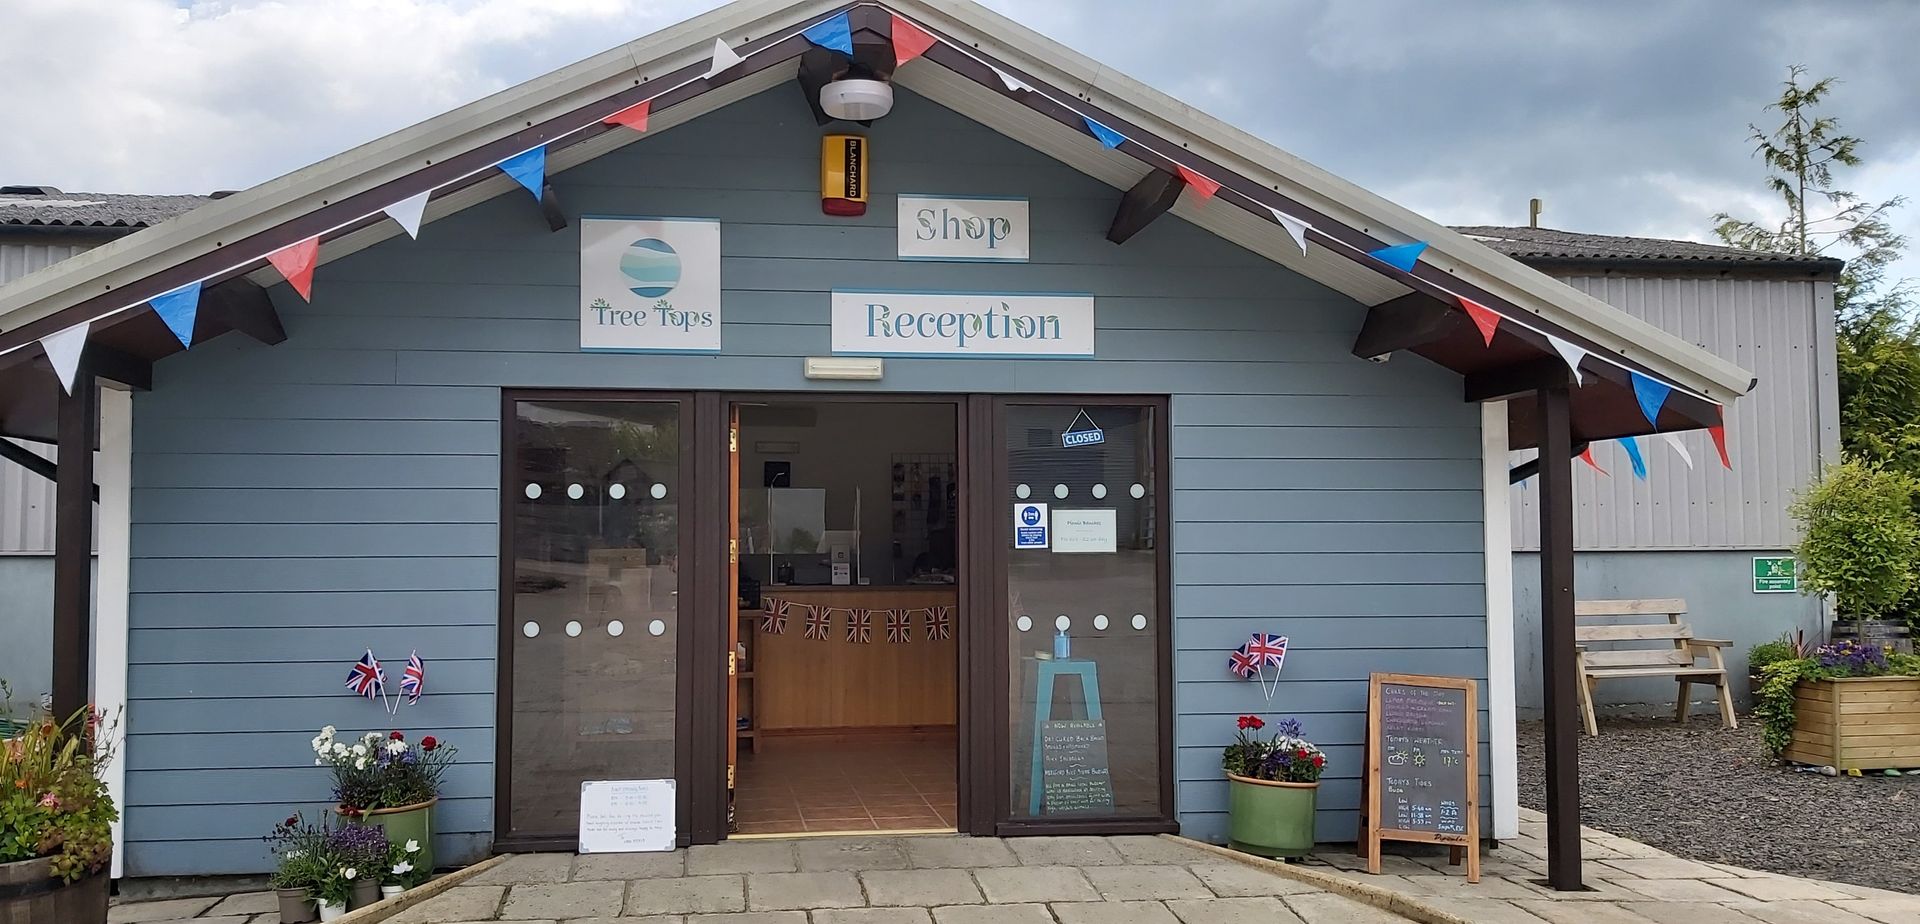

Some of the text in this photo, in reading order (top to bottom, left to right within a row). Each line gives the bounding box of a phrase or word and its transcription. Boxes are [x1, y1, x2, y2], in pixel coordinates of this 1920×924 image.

[849, 140, 857, 197] BLANCHARD
[916, 207, 1011, 249] Shop
[590, 299, 713, 333] Tree Tops
[864, 302, 1063, 348] Reception
[1066, 432, 1101, 445] CLOSED
